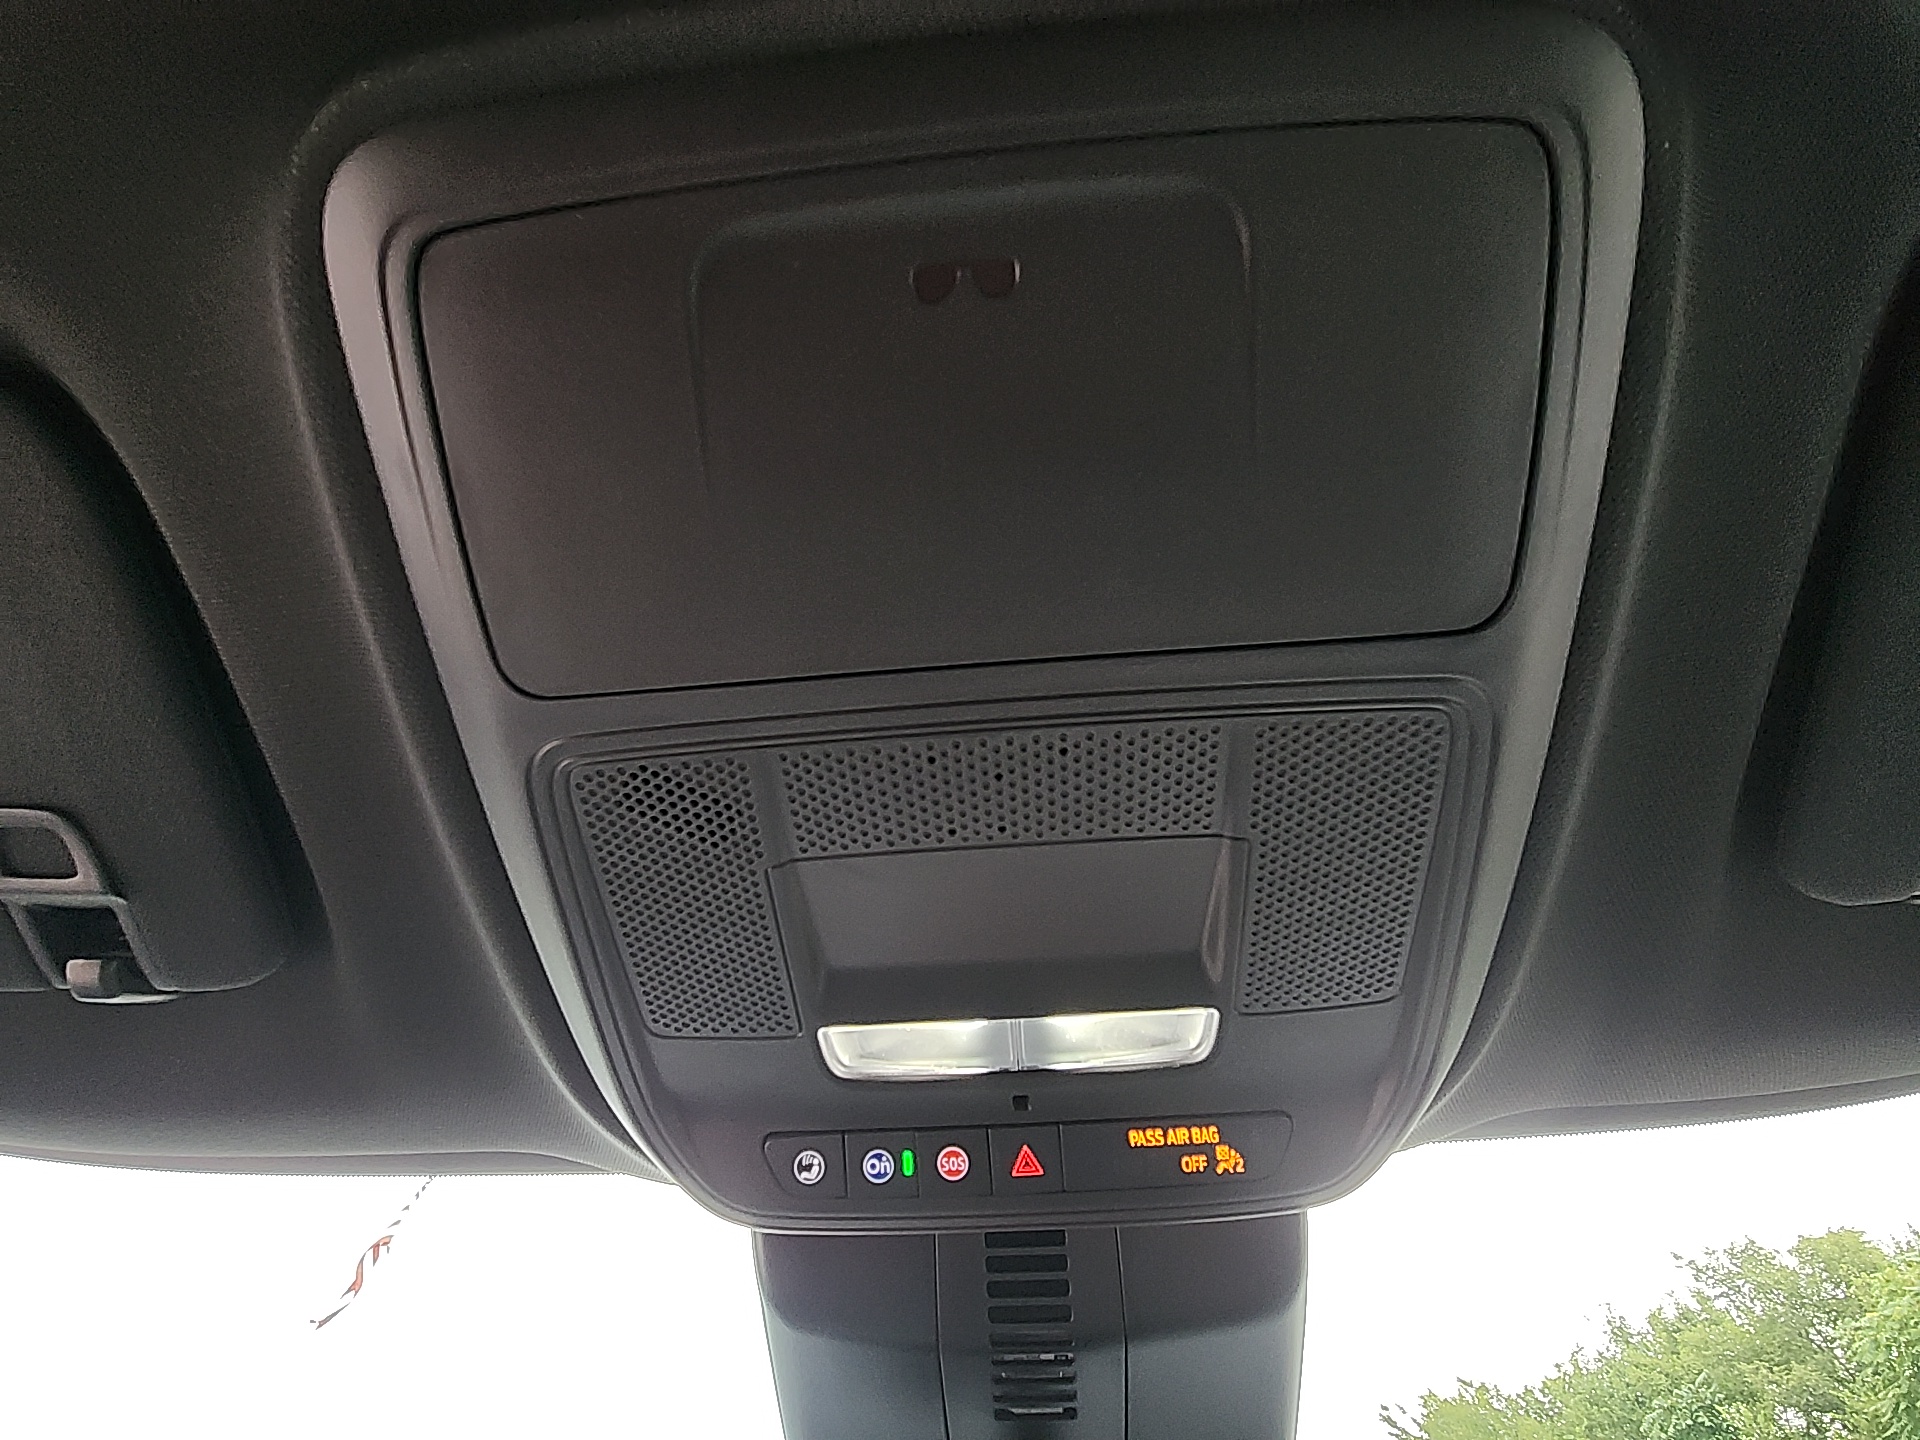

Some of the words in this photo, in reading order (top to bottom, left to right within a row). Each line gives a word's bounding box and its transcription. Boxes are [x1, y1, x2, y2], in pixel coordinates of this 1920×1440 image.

[1127, 1128, 1165, 1148] PASS
[1166, 1126, 1190, 1146] AIR
[1190, 1124, 1220, 1145] BAG
[941, 1157, 965, 1172] SOS
[1180, 1153, 1208, 1173] OFF
